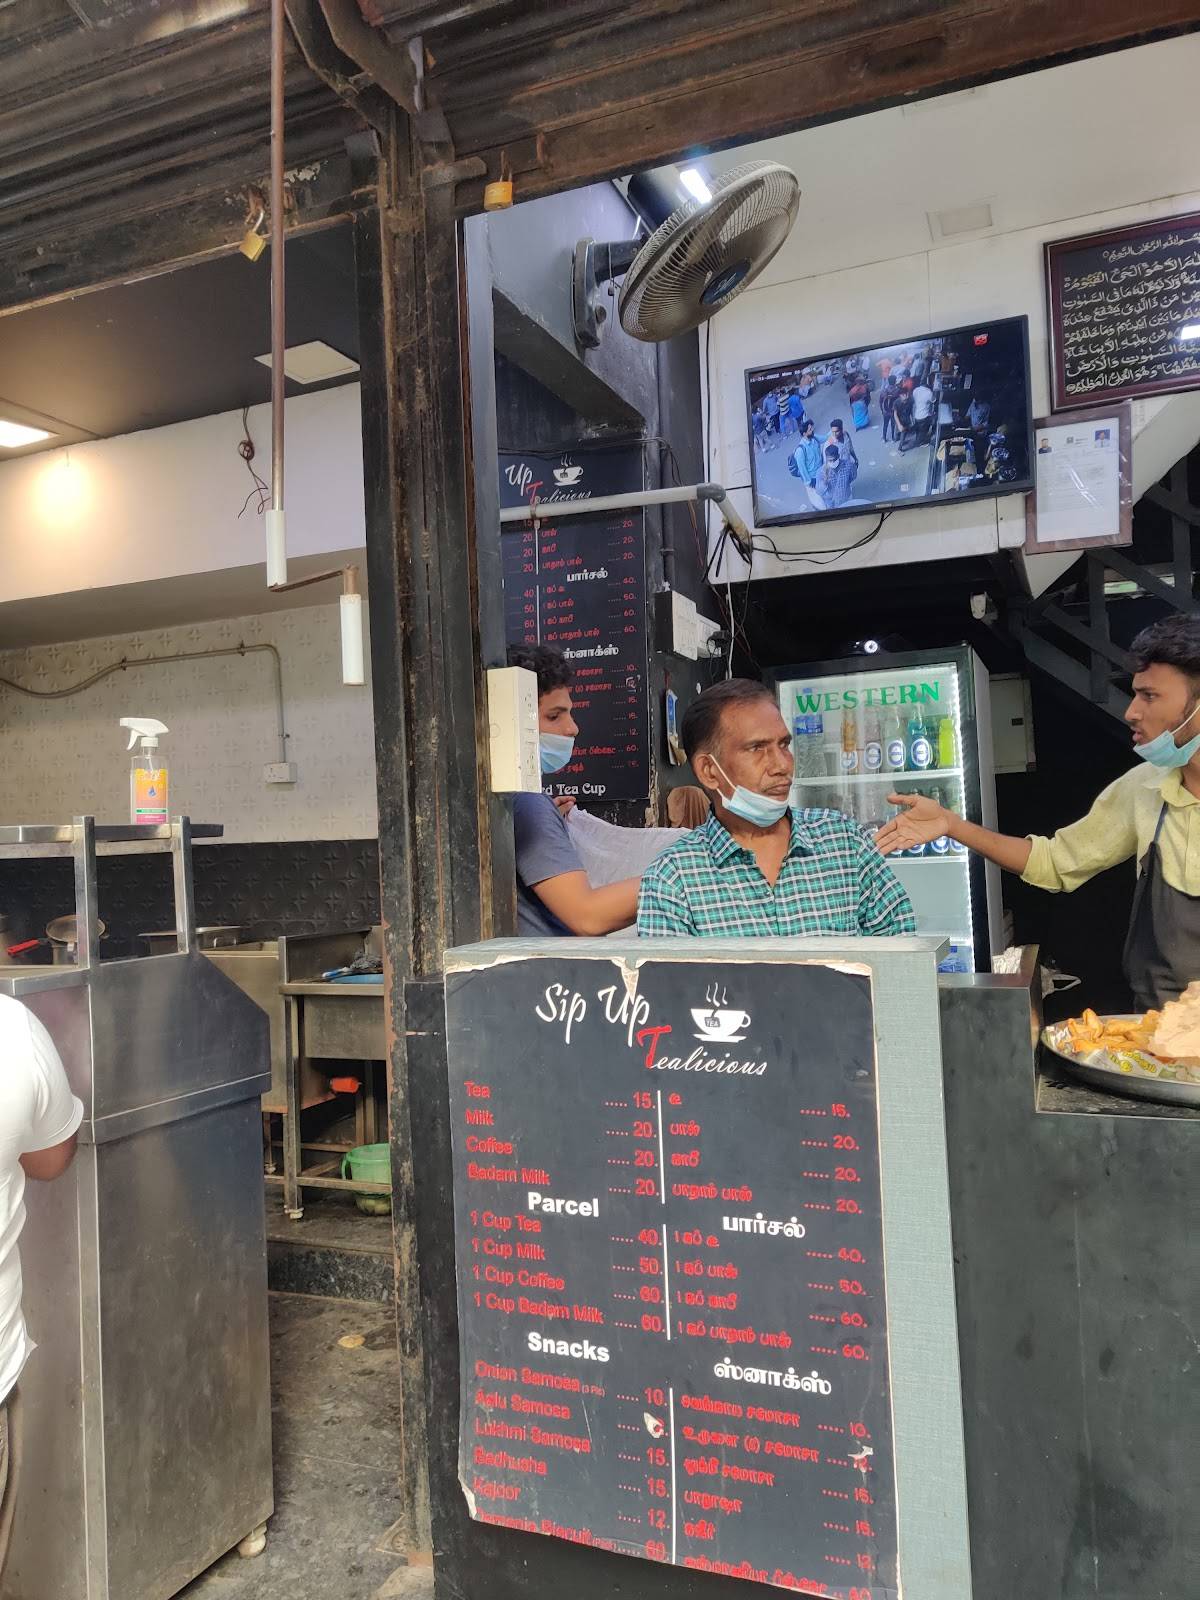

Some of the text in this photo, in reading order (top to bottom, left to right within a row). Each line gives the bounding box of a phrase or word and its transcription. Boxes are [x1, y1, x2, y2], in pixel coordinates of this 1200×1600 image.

[505, 463, 533, 497] Up
[566, 567, 608, 582] பார்சல்
[796, 681, 940, 714] WESTERN
[556, 783, 606, 798] Tea Cup
[536, 982, 650, 1047] Sip Up
[636, 1024, 768, 1076] Tealicious
[463, 1081, 656, 1109] Tea 15.
[464, 1109, 657, 1139] Milk 20.
[831, 1103, 851, 1119] 15.
[465, 1136, 659, 1168] Coffee 20.
[833, 1135, 860, 1151] 20.
[466, 1162, 660, 1197] Badam Milk 20.
[834, 1167, 861, 1183] 20.
[527, 1192, 600, 1217] Parcel
[835, 1199, 863, 1215] 20.
[470, 1210, 663, 1246] 1 Cup Tea 40.
[722, 1212, 806, 1239] பார்சல்
[471, 1238, 663, 1276] 1 Cup Milk 50.
[838, 1248, 867, 1263] 40.
[472, 1265, 480, 1280] 1
[485, 1266, 515, 1286] Cup
[518, 1270, 565, 1291] Coffee
[839, 1280, 868, 1296] 50.
[473, 1291, 666, 1333] 1 Cup Badam Milk 60.
[840, 1312, 868, 1328] 60.
[528, 1331, 610, 1362] Snacks
[842, 1344, 870, 1360] 60.
[474, 1360, 517, 1382] Onion
[521, 1367, 581, 1392] Samosa
[643, 1387, 668, 1407] 10.
[714, 1357, 833, 1395] ஸ்னாக்ஸ்
[511, 1394, 571, 1420] Samosa
[474, 1420, 670, 1467] Lukhmi Samosa 15.
[849, 1421, 872, 1439] 10.
[473, 1446, 670, 1498] Badhusha 15.
[472, 1477, 671, 1529] Kajoor 12.
[854, 1487, 874, 1505] 15.
[855, 1520, 875, 1537] 15.
[856, 1554, 875, 1570] 12.
